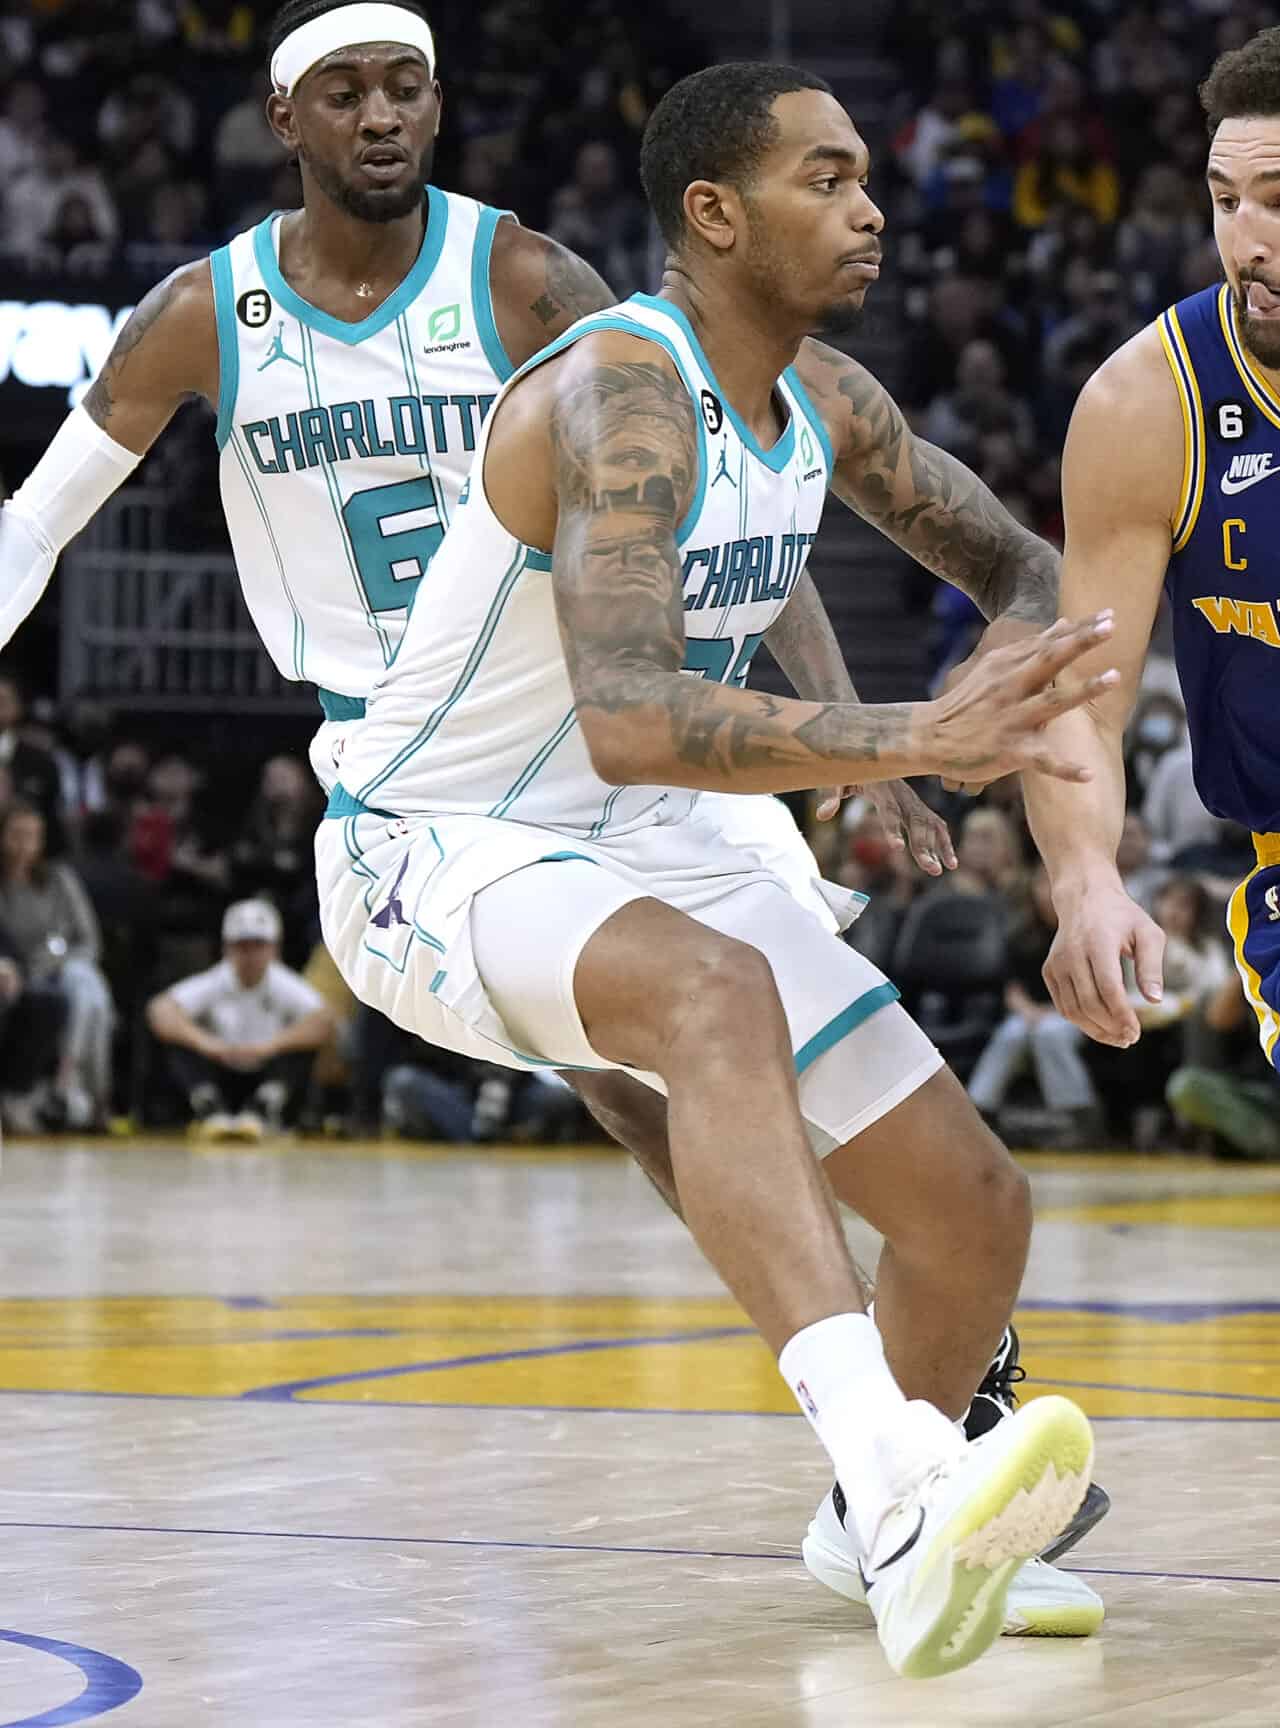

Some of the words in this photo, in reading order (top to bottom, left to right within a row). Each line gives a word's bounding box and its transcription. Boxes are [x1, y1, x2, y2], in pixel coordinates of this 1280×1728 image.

[245, 293, 268, 324] 6
[423, 339, 471, 355] lendingtree
[702, 396, 719, 432] 6
[1217, 404, 1244, 438] 6
[1228, 453, 1274, 479] NIKE
[341, 473, 446, 613] 6
[1222, 518, 1248, 571] C
